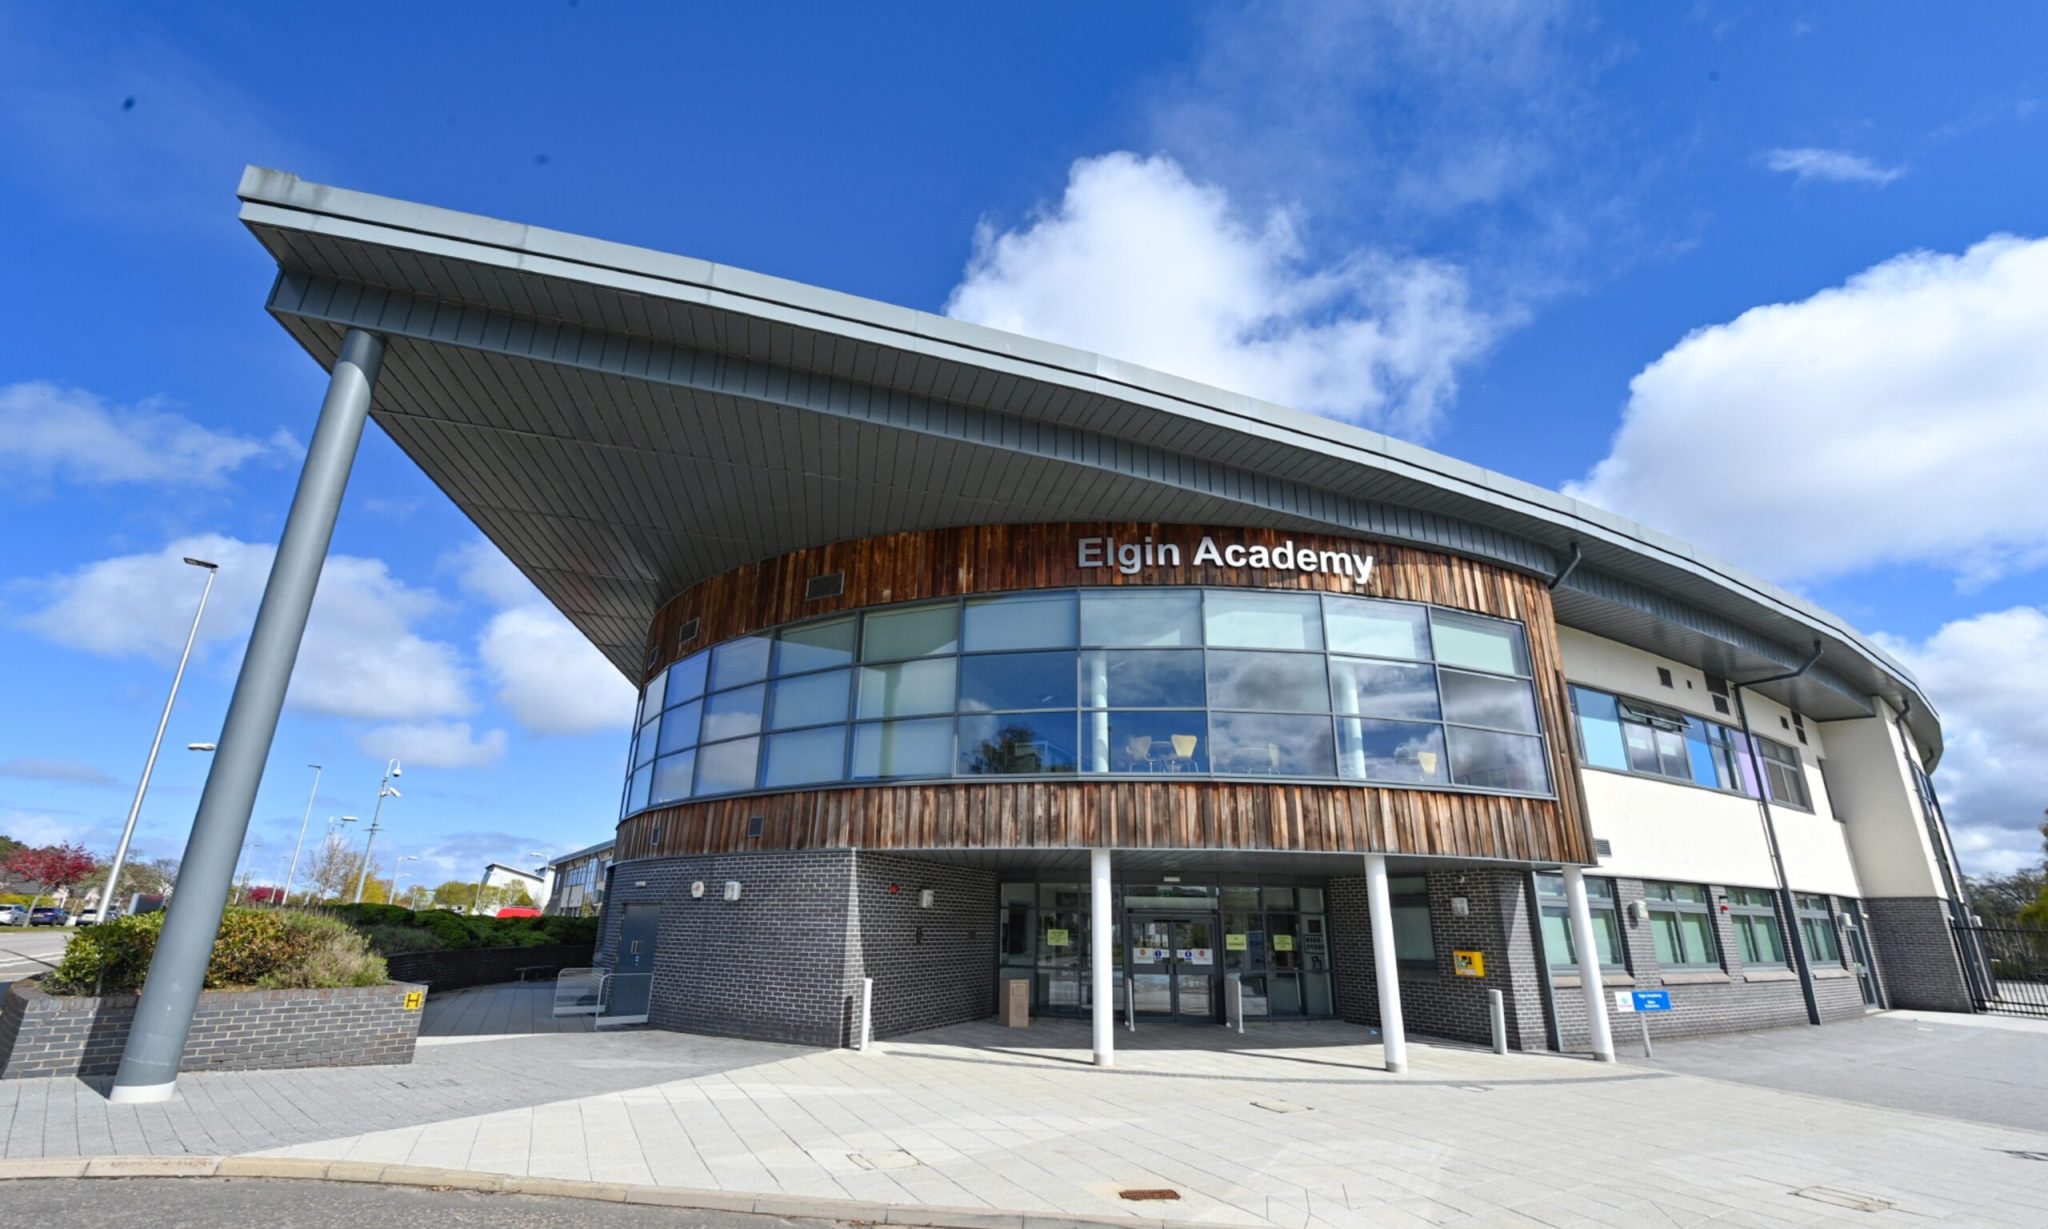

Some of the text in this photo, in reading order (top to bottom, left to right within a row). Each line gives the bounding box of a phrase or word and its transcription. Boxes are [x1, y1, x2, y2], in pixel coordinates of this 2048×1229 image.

[1078, 536, 1374, 584] Elgin Academy
[406, 993, 421, 1008] H
